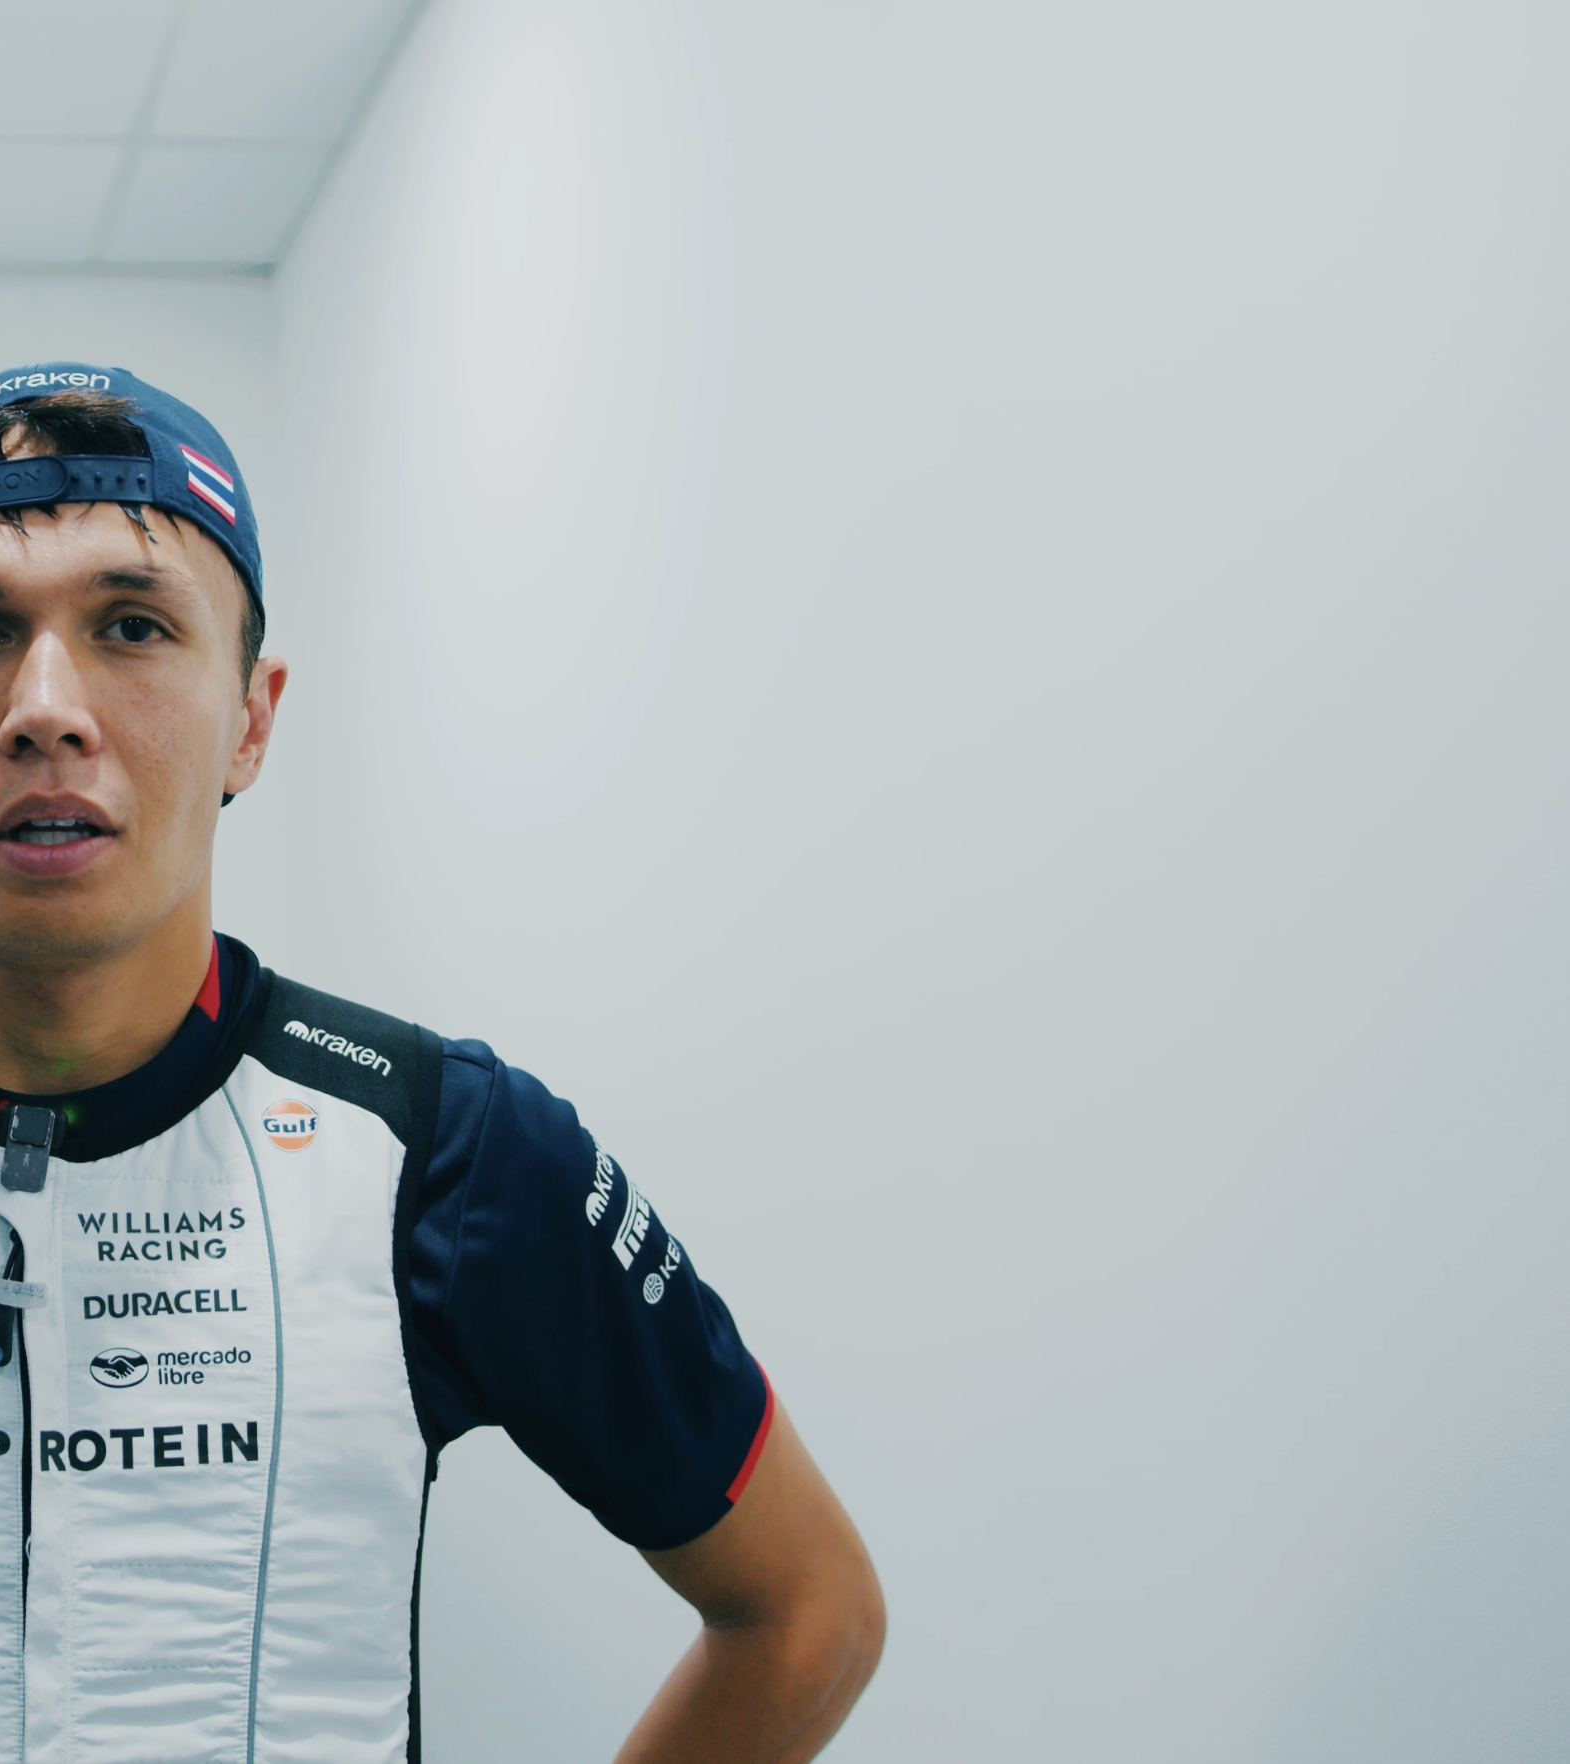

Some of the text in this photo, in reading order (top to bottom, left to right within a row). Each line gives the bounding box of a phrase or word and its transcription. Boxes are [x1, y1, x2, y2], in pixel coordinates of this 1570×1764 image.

[263, 1117, 317, 1133] Gulf
[77, 1207, 246, 1234] WILLIAMS
[611, 1180, 650, 1271] PIRE
[97, 1238, 227, 1262] RACING
[658, 1234, 681, 1280] KE
[83, 1289, 247, 1320] DURACELL
[157, 1346, 252, 1366] mercado
[157, 1367, 205, 1386] libre
